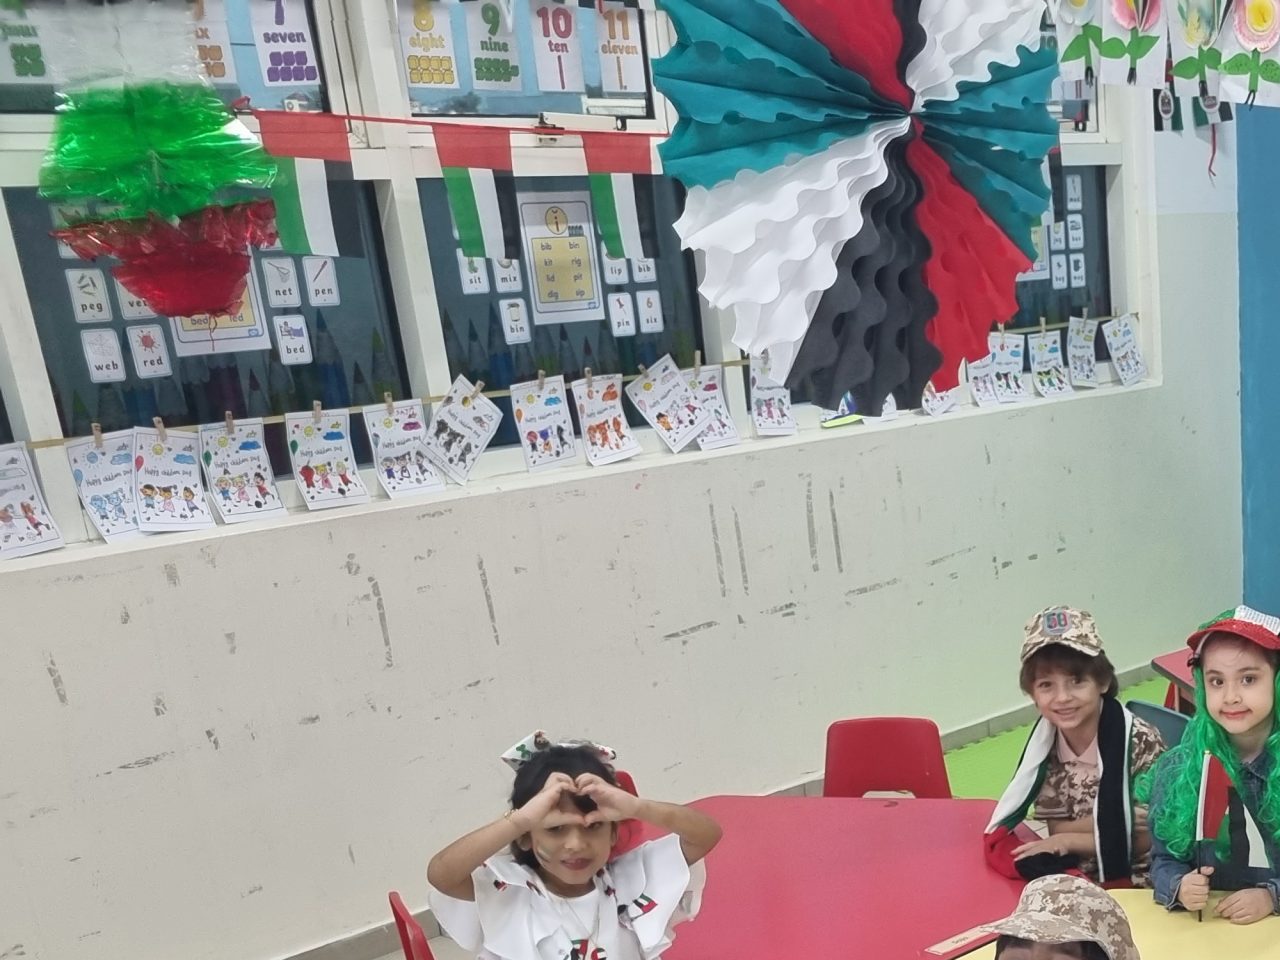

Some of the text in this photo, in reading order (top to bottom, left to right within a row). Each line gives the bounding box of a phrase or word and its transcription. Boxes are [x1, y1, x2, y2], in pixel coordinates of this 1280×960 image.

[481, 3, 500, 36] 9
[536, 6, 572, 39] 10
[603, 8, 631, 40] 11
[262, 31, 307, 44] seven
[408, 32, 446, 52] eight
[480, 37, 509, 52] nine
[547, 39, 569, 53] ten
[601, 40, 639, 55] eleven
[638, 264, 651, 273] bib
[469, 276, 482, 284] sit
[500, 274, 517, 283] mix
[274, 287, 293, 297] net
[314, 287, 333, 297] pen
[81, 302, 103, 313] peg
[646, 297, 653, 308] 6
[190, 315, 209, 326] bed
[617, 319, 630, 328] pin
[510, 324, 525, 333] bin
[286, 344, 305, 354] bed
[94, 361, 119, 371] web
[143, 356, 163, 367] red
[1046, 612, 1068, 629] 50
